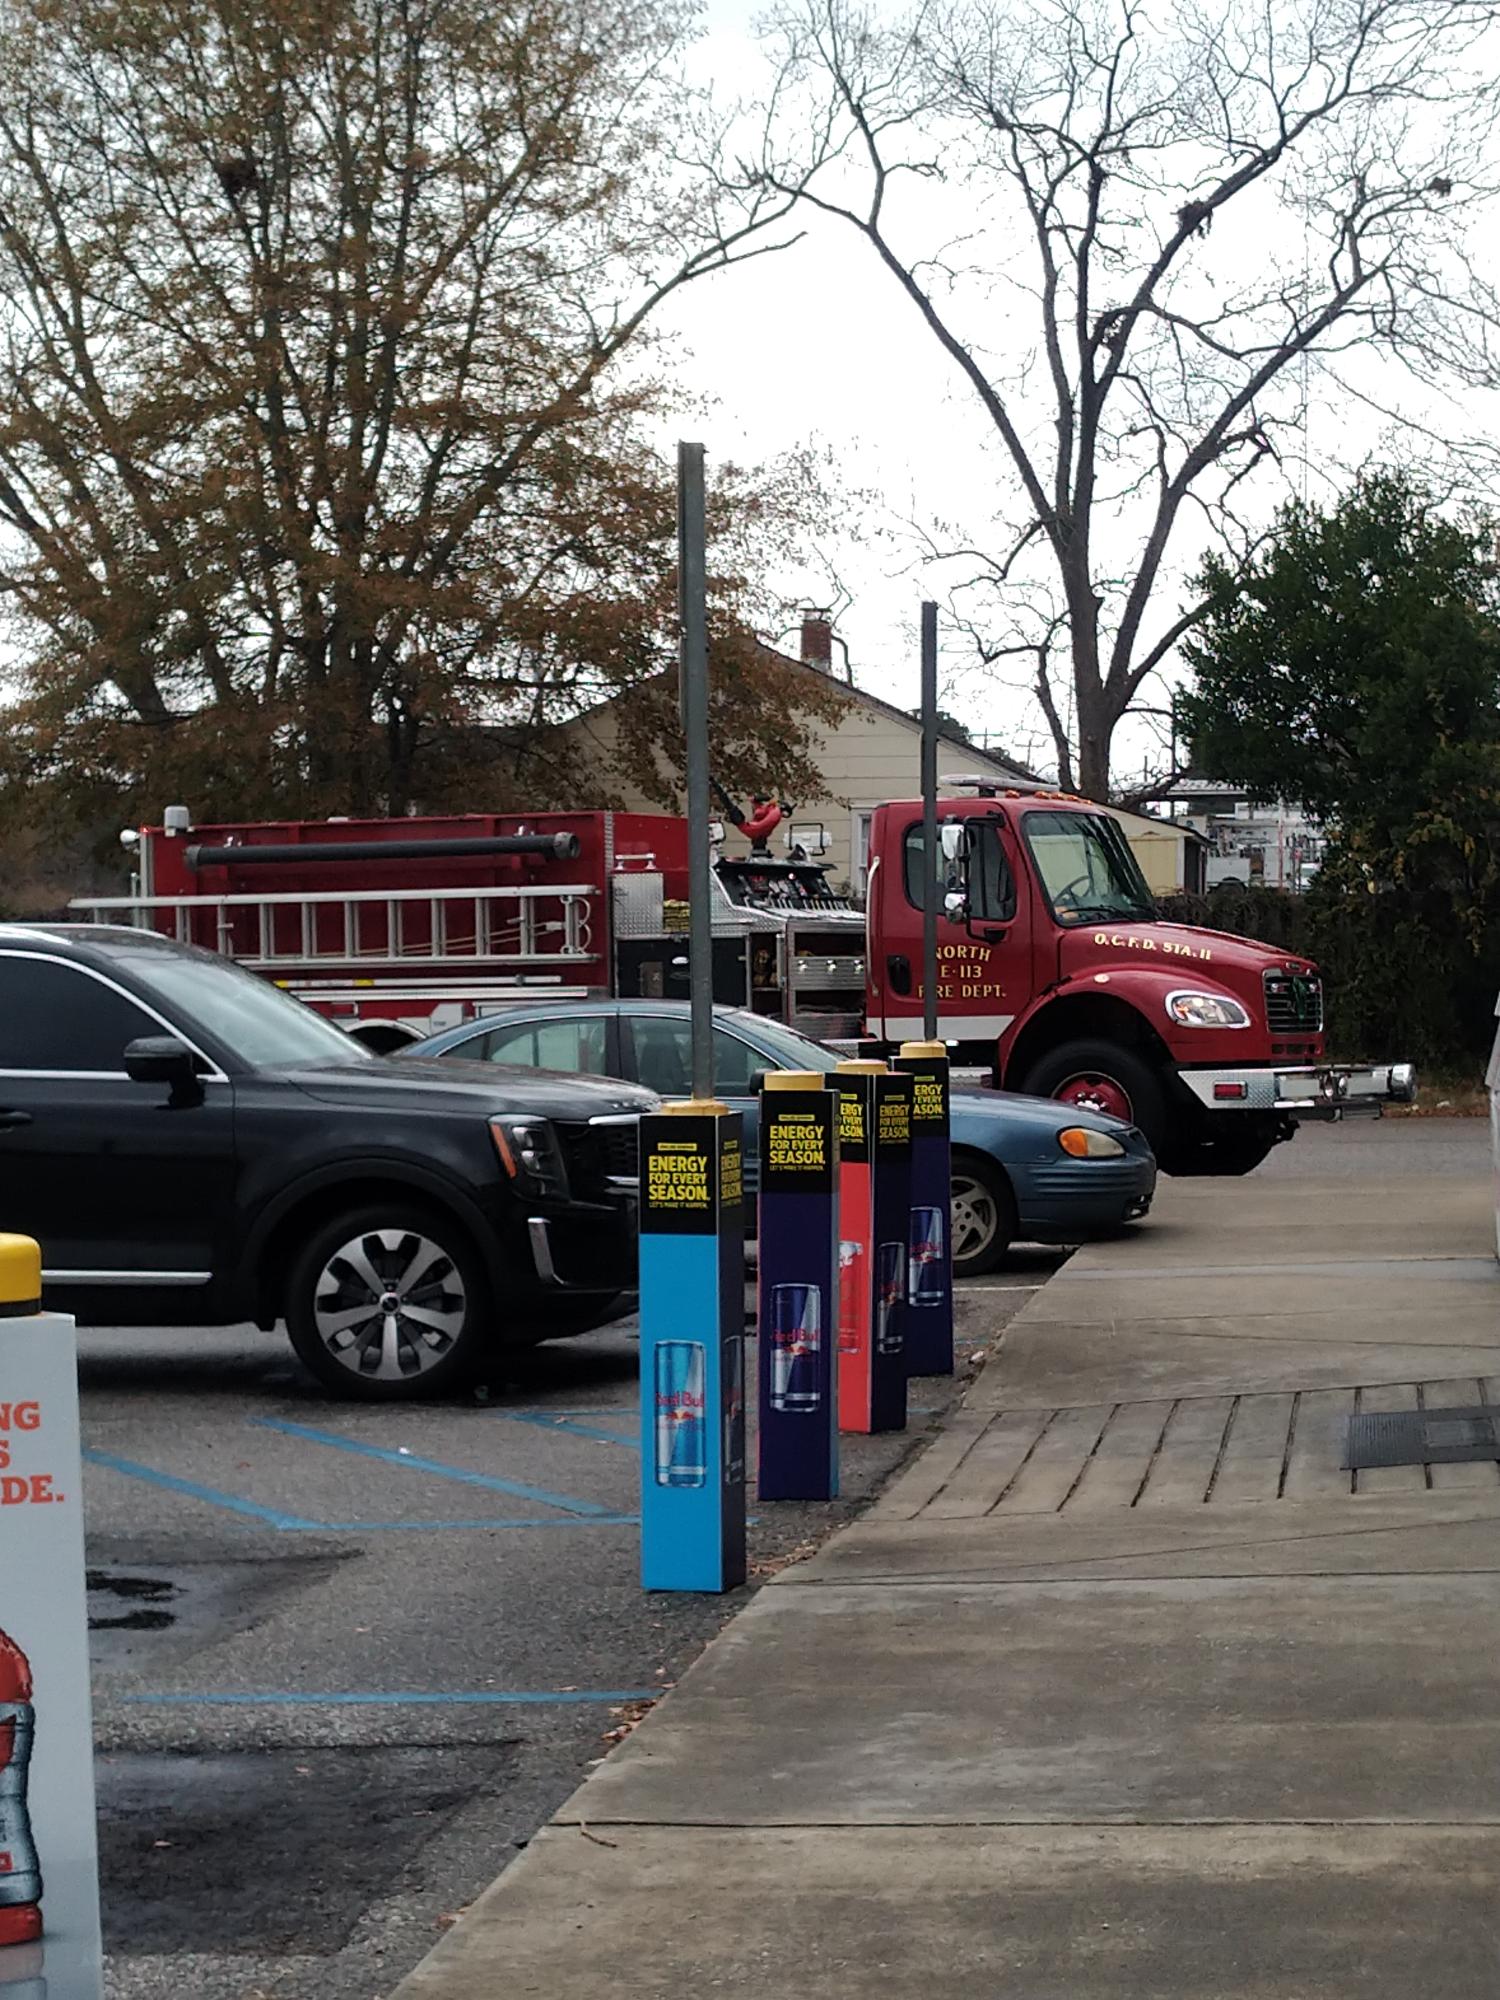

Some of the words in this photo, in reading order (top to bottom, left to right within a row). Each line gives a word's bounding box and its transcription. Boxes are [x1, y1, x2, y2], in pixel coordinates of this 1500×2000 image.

[1162, 941, 1197, 957] STA.
[919, 984, 953, 998] FRE
[962, 984, 1007, 998] DEPT.
[914, 1084, 942, 1096] ERGY
[913, 1104, 944, 1115] ASON.
[769, 1125, 824, 1139] ENERGY
[769, 1140, 790, 1150] FOR
[791, 1140, 824, 1150] EVERY
[648, 1155, 708, 1171] ENERGY
[769, 1150, 826, 1164] SEASON.
[648, 1172, 671, 1184] FOR
[672, 1172, 706, 1184] EVERY
[648, 1185, 711, 1200] SEASON.
